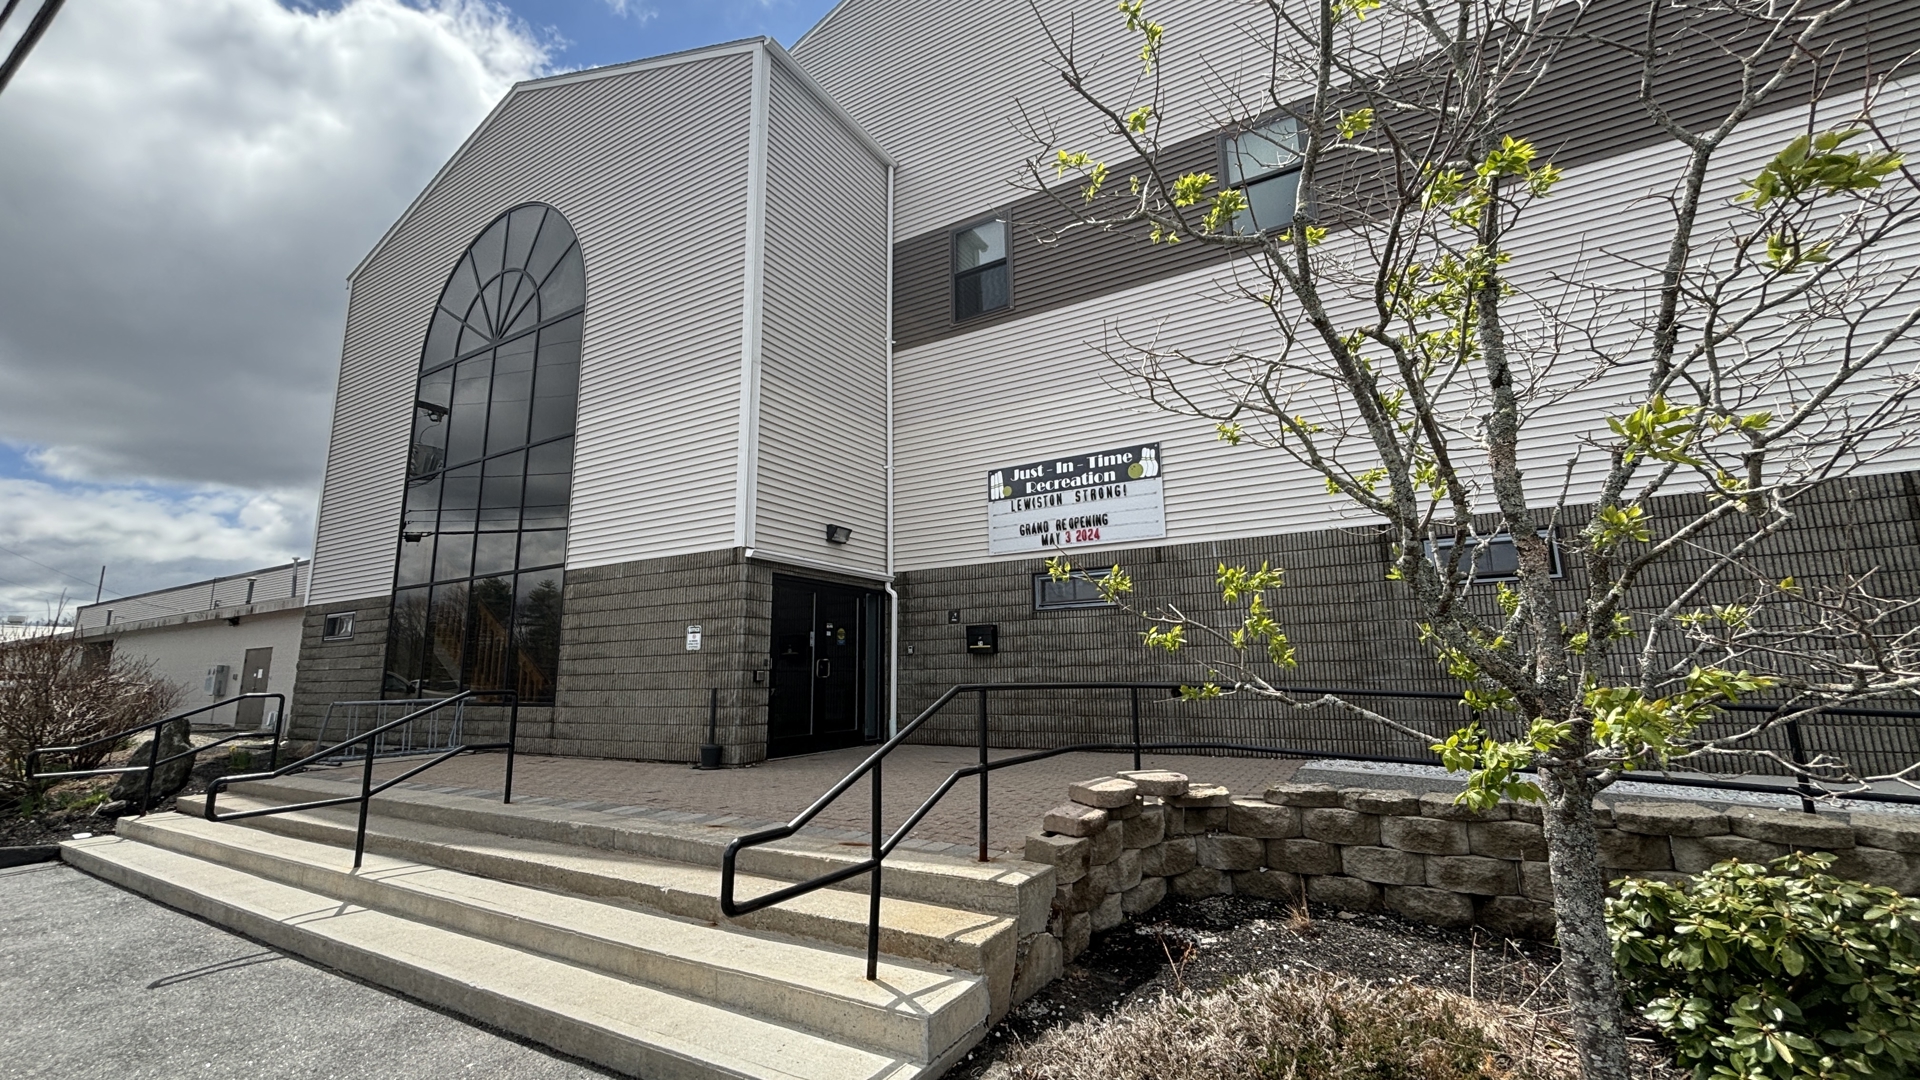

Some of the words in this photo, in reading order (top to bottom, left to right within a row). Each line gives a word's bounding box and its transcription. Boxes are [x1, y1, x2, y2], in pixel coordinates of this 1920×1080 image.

[1010, 464, 1044, 482] Just
[1056, 461, 1074, 474] In
[1087, 452, 1133, 469] Time
[1026, 470, 1116, 494] Recreation
[1010, 493, 1062, 512] LEWISTON
[1075, 484, 1128, 503] STRONG!
[1019, 522, 1049, 536] GRAND
[1041, 532, 1061, 546] MAY
[1065, 530, 1071, 543] 3
[1076, 527, 1100, 542] 2024
